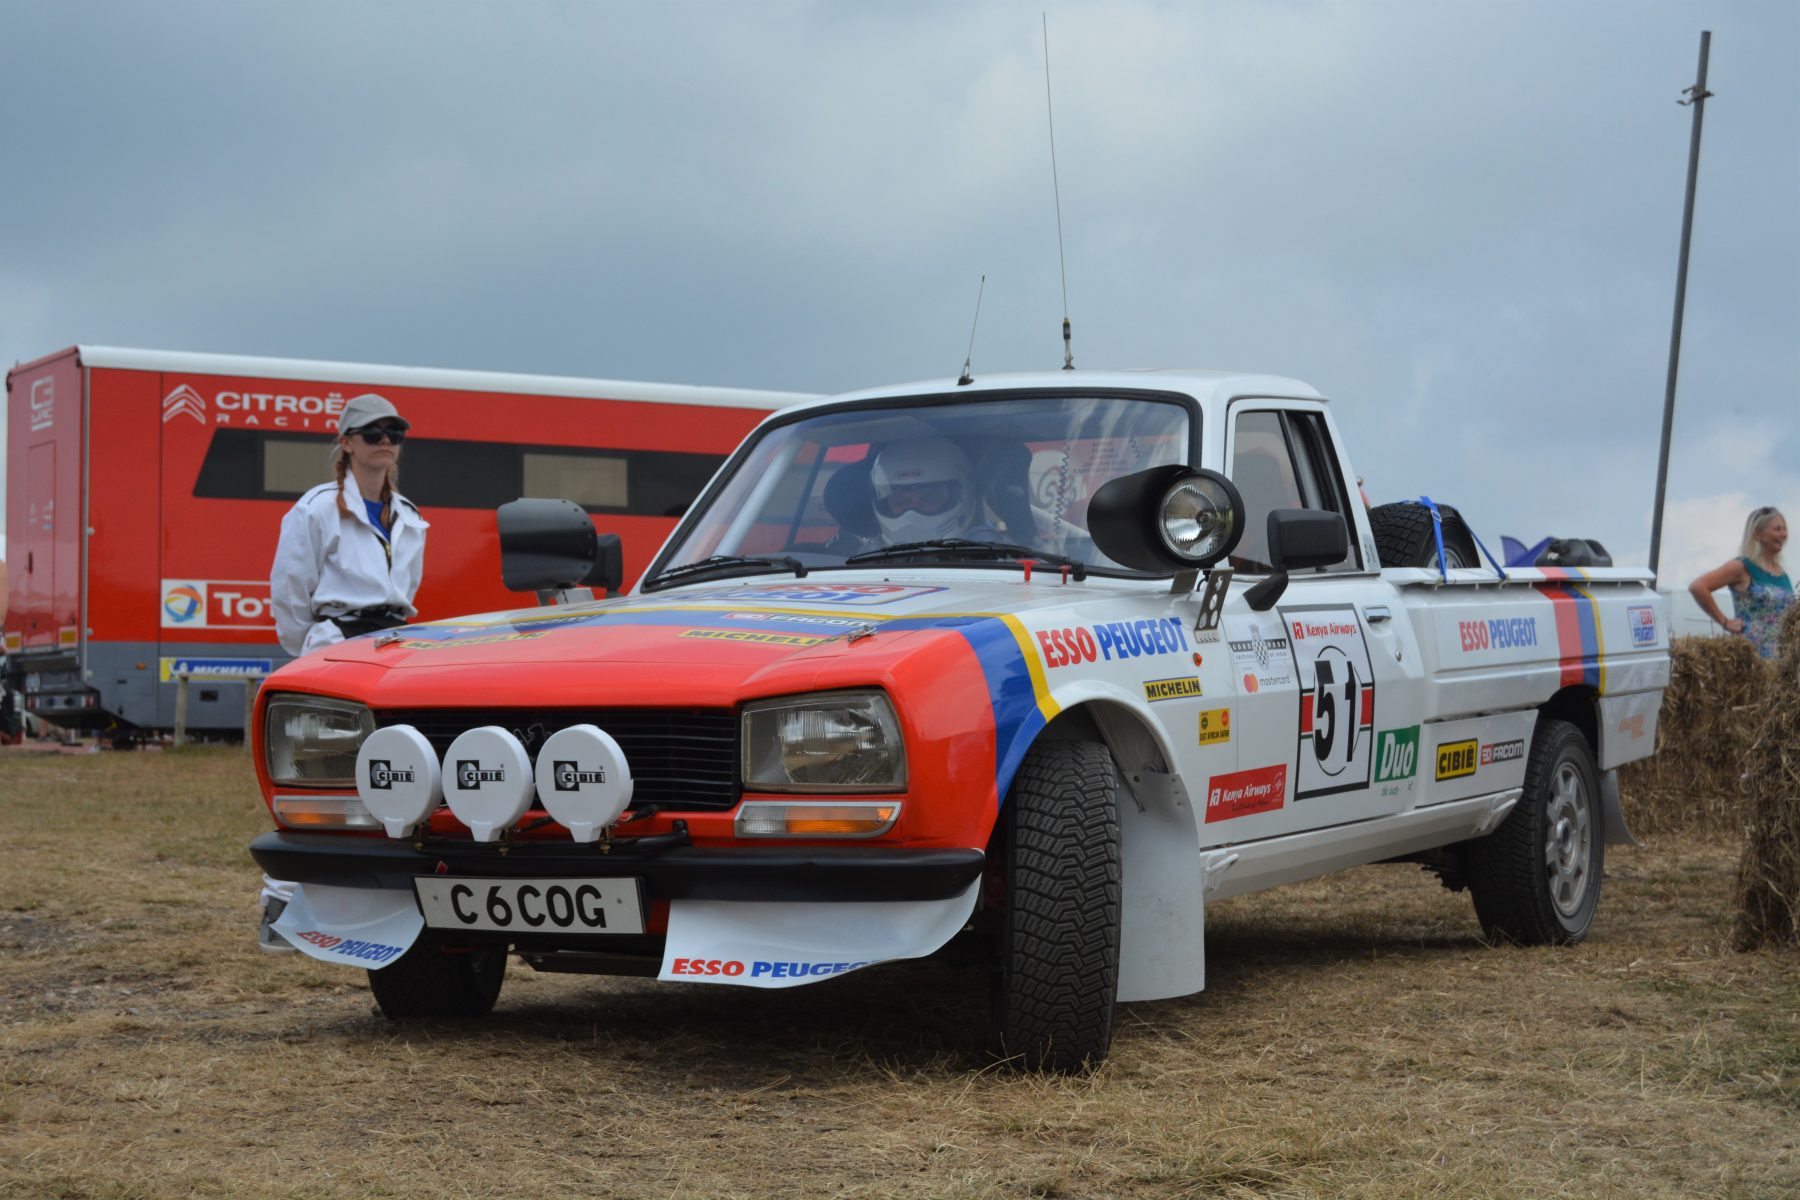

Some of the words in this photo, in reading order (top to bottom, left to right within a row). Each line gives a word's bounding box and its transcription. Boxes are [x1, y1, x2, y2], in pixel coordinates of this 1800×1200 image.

[215, 391, 346, 415] CITROË
[215, 413, 340, 428] RACIN
[1305, 623, 1328, 639] Kenya
[1329, 622, 1357, 638] Airways
[1458, 620, 1489, 652] ESSO
[1488, 617, 1537, 649] PEUGEOT
[1035, 626, 1097, 669] ESSO
[1092, 616, 1189, 661] PEUGEOT
[1146, 680, 1201, 698] MICHELIN
[1314, 660, 1357, 763] 51
[1493, 742, 1523, 760] FACOM
[1223, 787, 1243, 802] Kenya
[1243, 783, 1271, 797] Airways
[296, 930, 342, 949] ESSO
[328, 939, 404, 963] PEUGEOT
[671, 958, 745, 977] ESSO
